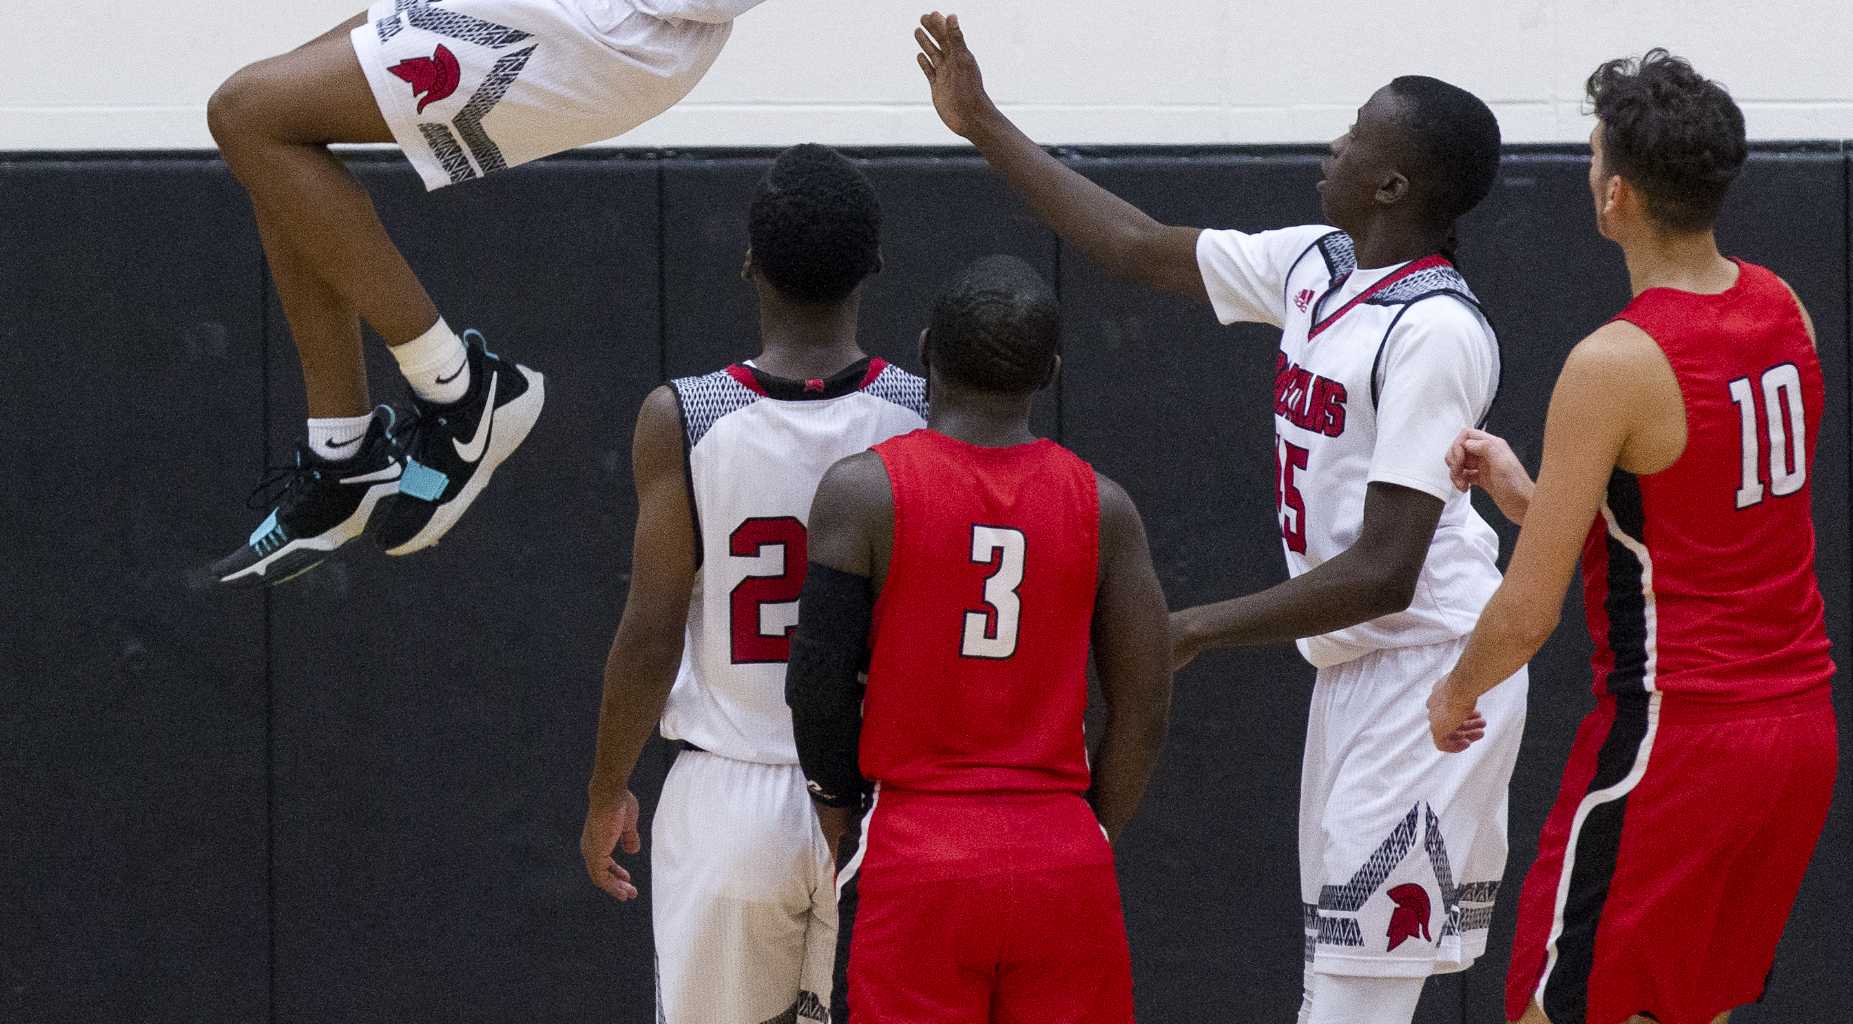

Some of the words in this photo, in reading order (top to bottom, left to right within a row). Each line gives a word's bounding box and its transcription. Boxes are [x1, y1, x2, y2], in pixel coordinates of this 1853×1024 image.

[1728, 361, 1807, 511] 10
[729, 516, 808, 664] 2
[958, 522, 1026, 660] 3
